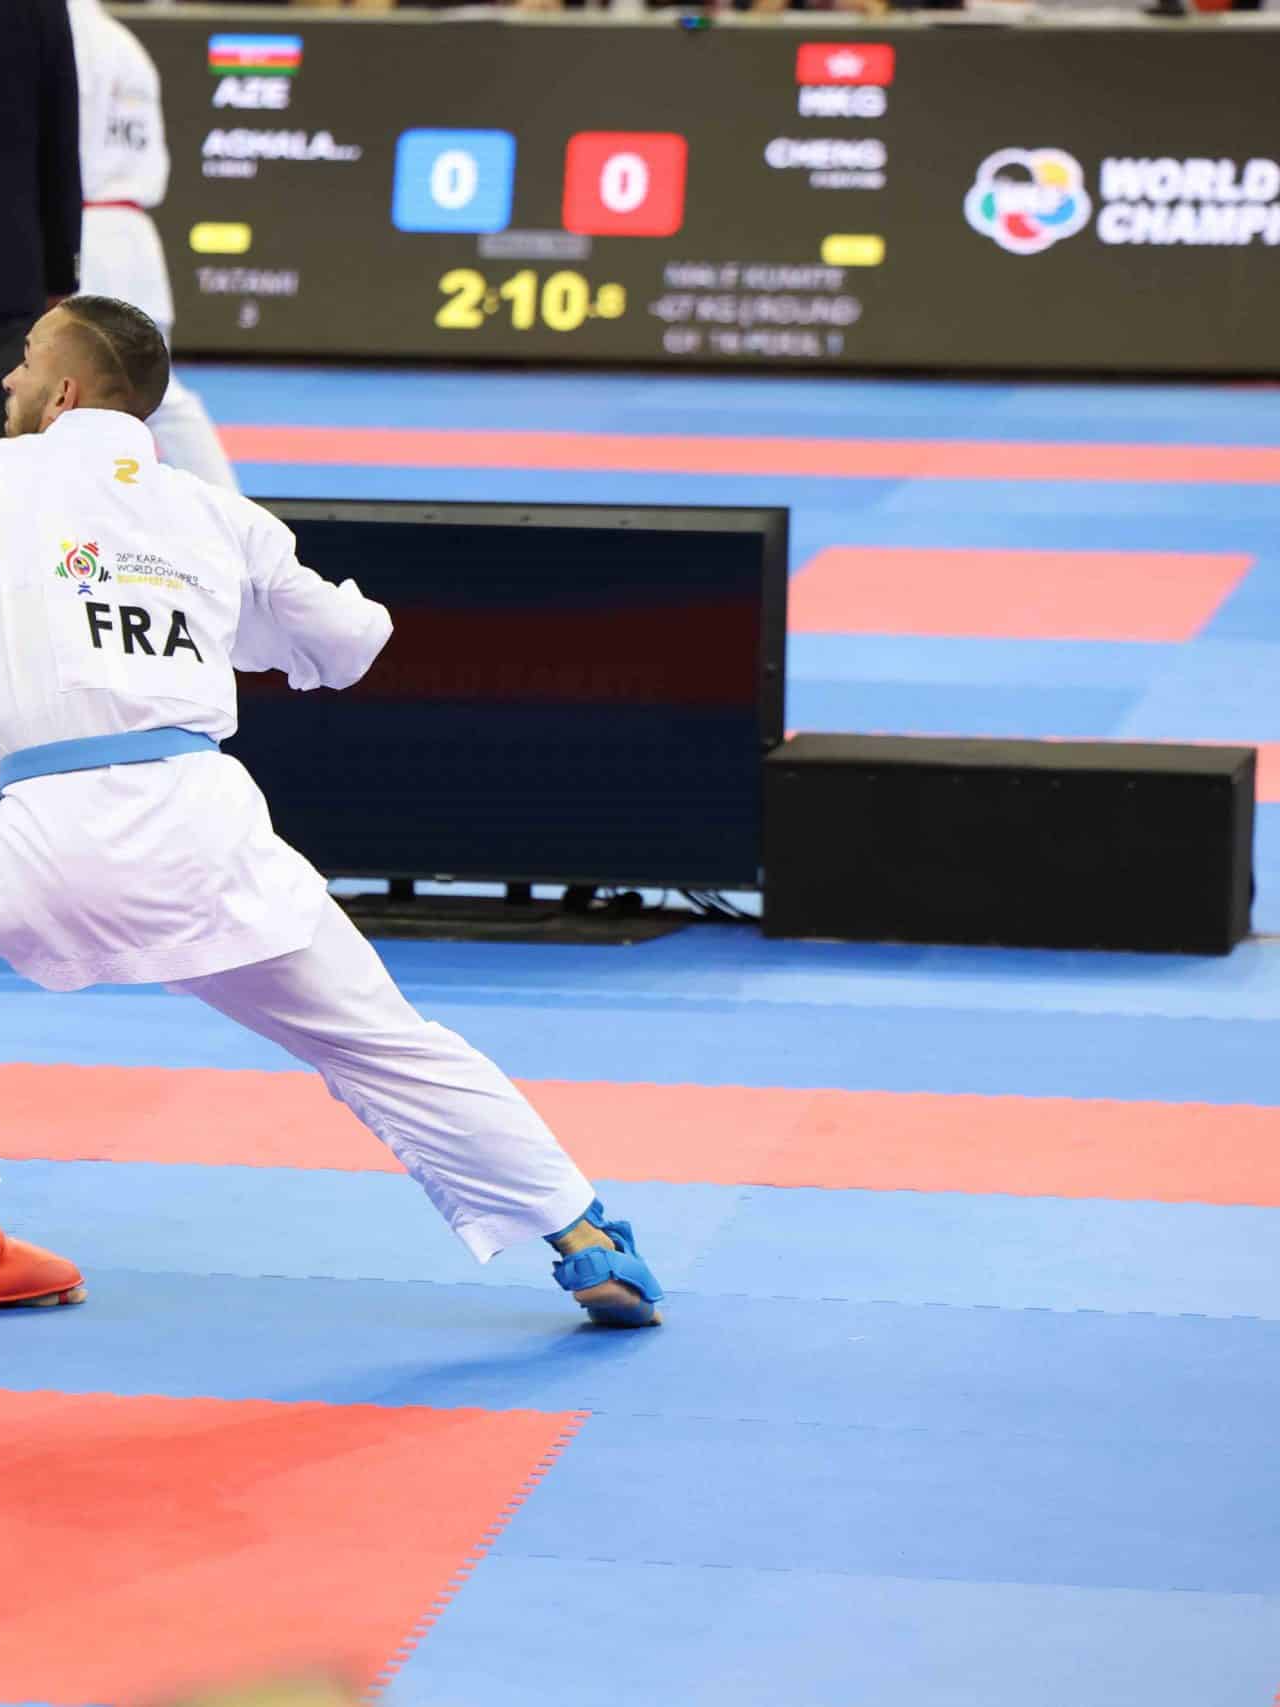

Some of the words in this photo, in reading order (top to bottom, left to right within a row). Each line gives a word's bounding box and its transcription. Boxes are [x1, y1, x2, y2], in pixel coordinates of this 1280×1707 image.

[431, 149, 478, 211] 0
[600, 152, 649, 213] 0
[1099, 157, 1280, 203] WORLD
[434, 267, 626, 332] 2:10.8
[86, 601, 204, 664] FRA
